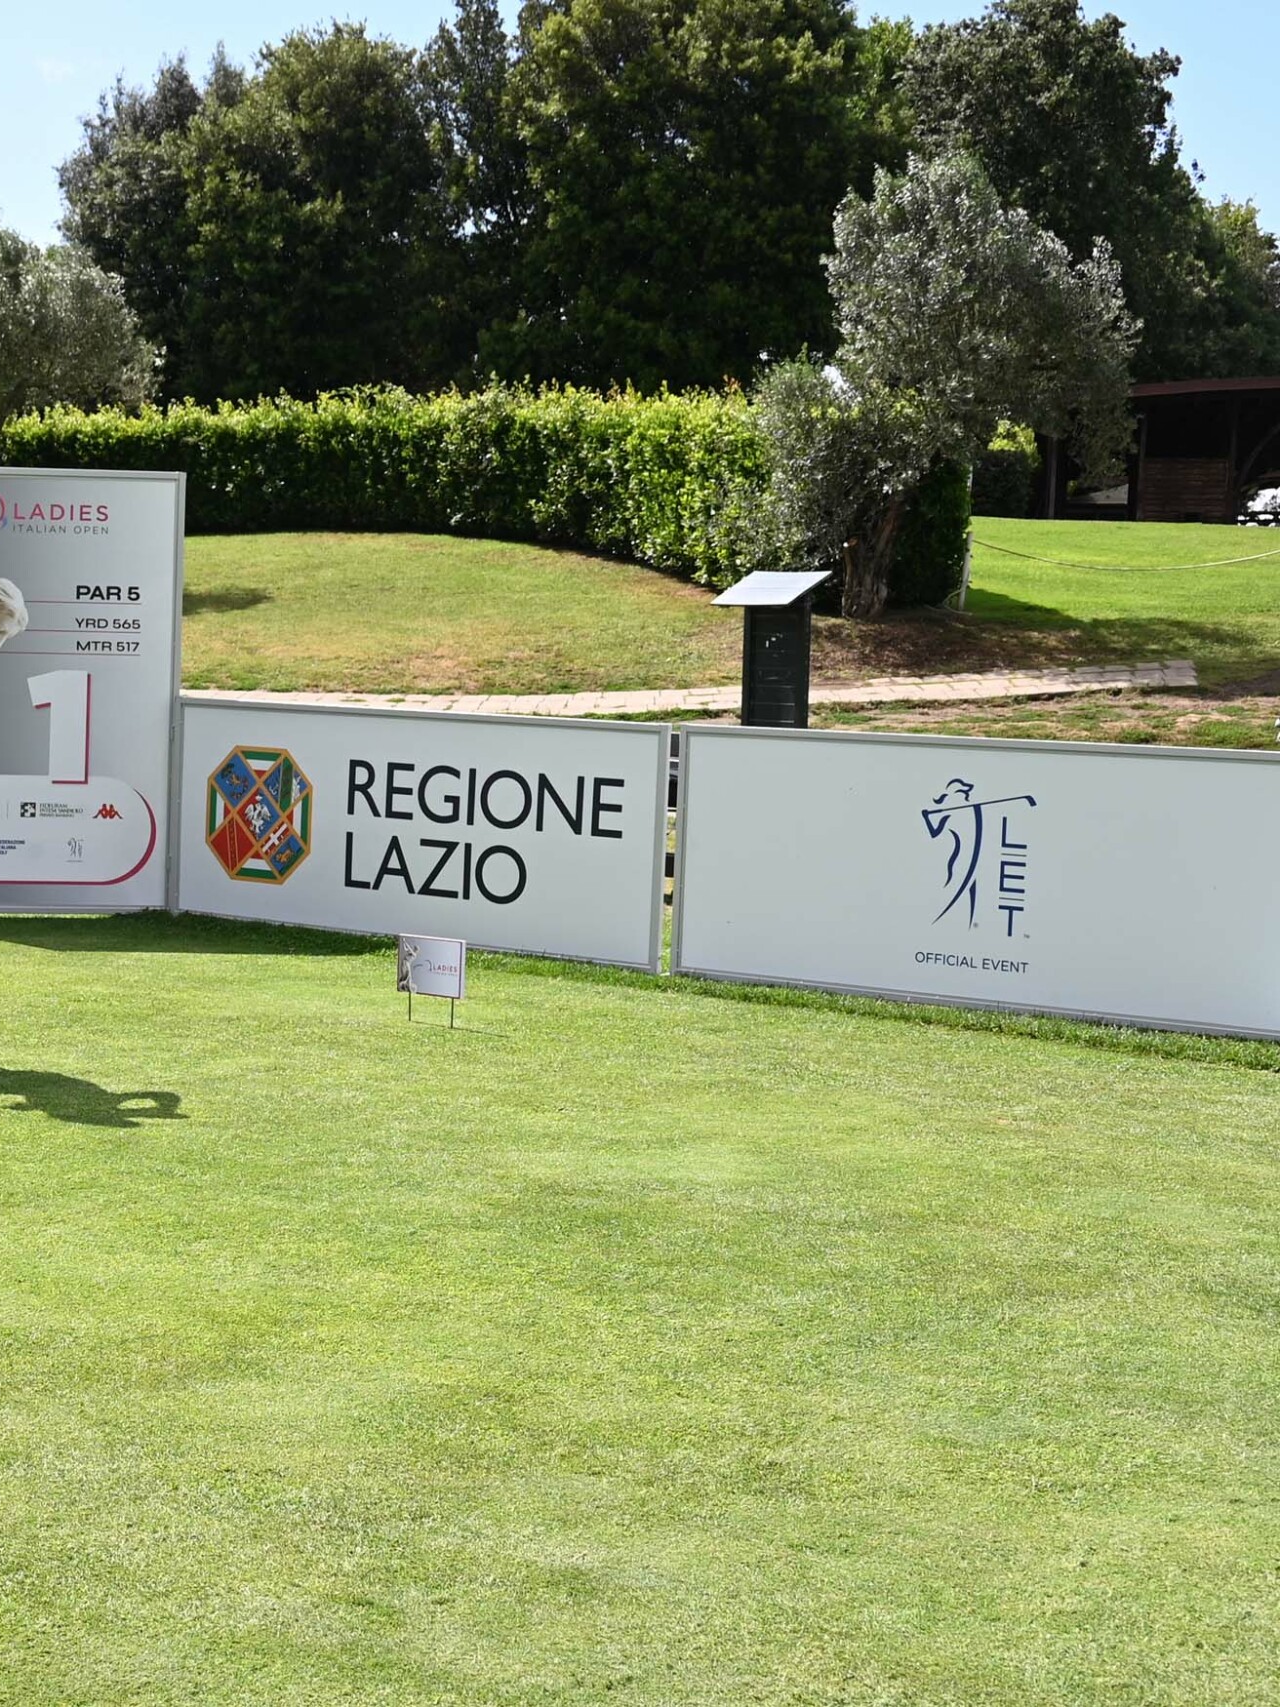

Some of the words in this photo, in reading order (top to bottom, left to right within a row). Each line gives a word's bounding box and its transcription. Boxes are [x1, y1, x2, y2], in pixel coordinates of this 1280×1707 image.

[13, 502, 109, 522] LADIES
[12, 524, 67, 534] ITALIAN
[73, 525, 109, 535] OPEN
[75, 585, 121, 601] PAR
[127, 586, 141, 601] 5
[75, 618, 110, 630] YRD
[113, 618, 141, 630] 565
[76, 640, 113, 652] MTR
[116, 641, 140, 653] 517
[27, 670, 91, 784] 1
[346, 759, 625, 839] REGIONE
[344, 831, 527, 905] LAZIO
[998, 816, 1027, 937] LET
[432, 963, 458, 973] LADIES
[915, 951, 978, 969] OFFICIAL
[982, 958, 1029, 973] EVENT
